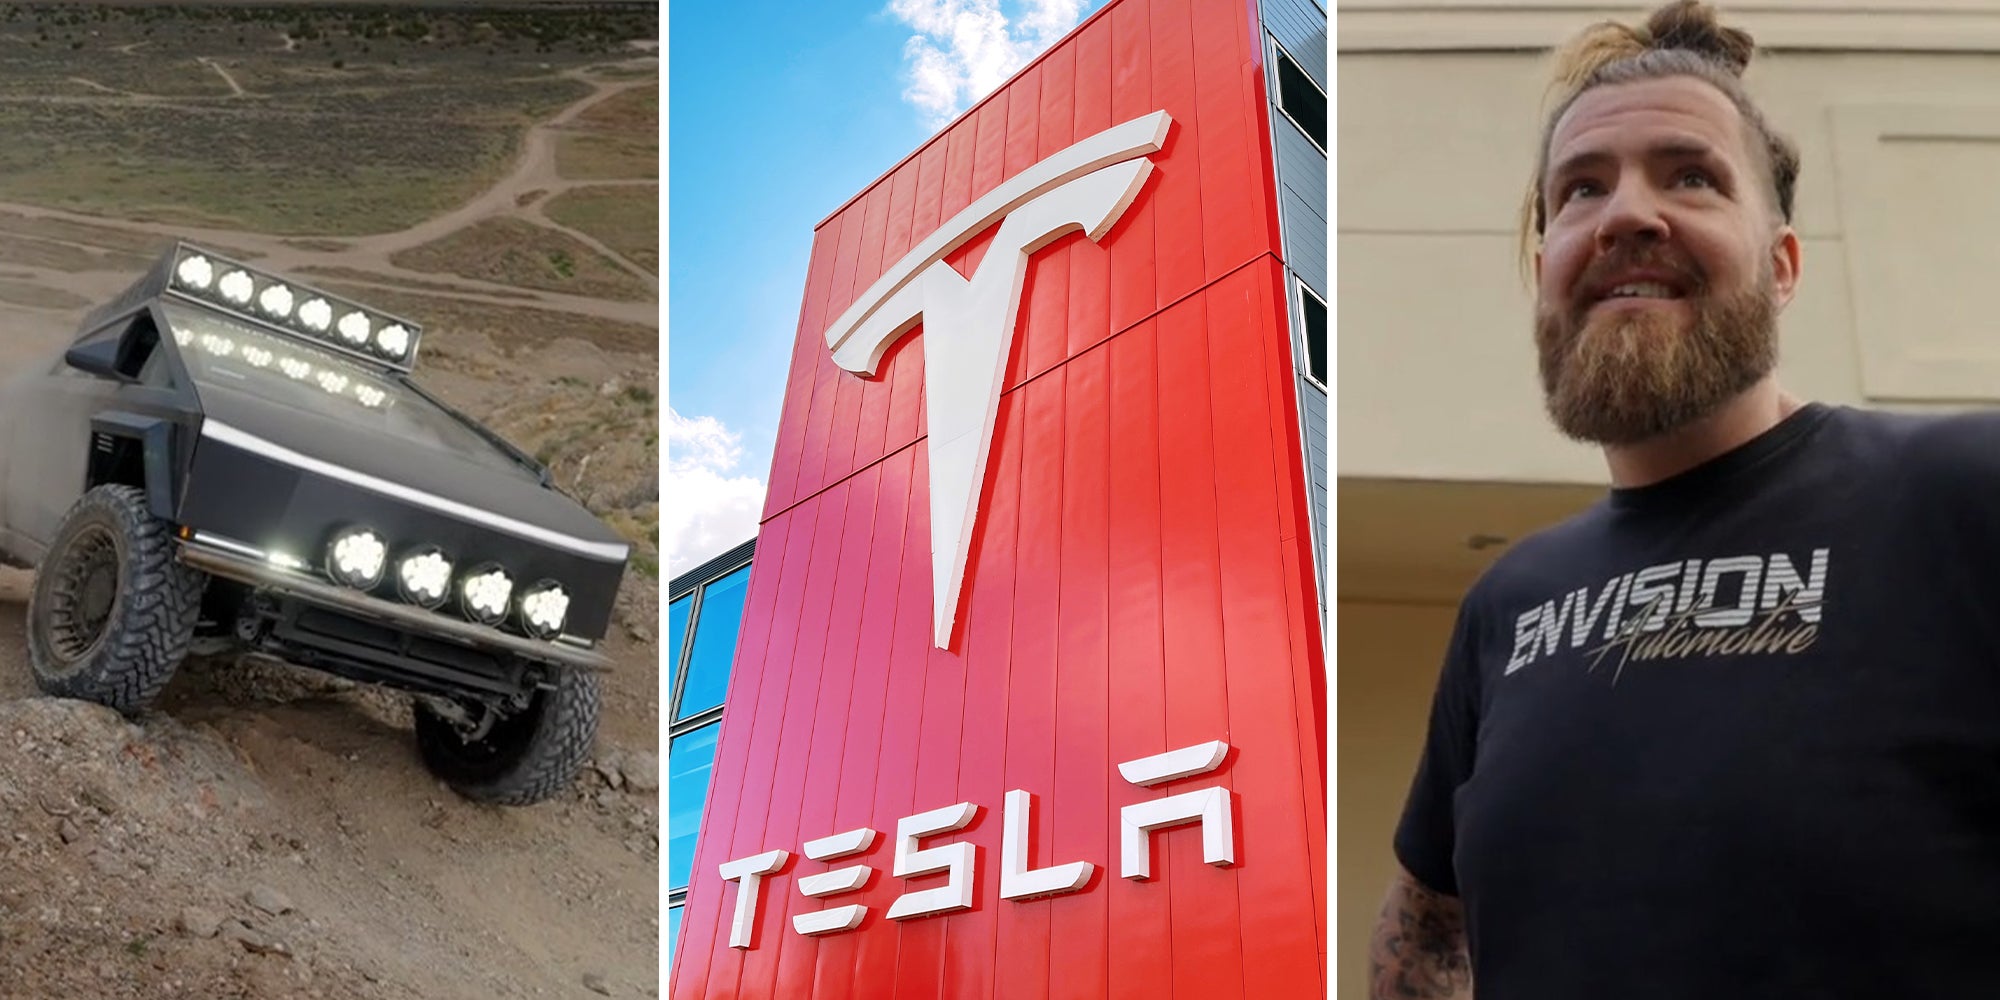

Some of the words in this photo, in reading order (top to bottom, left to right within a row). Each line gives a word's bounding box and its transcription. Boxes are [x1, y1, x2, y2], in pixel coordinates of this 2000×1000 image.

[1504, 548, 1830, 676] ENVISION
[1585, 588, 1828, 687] Automotive
[719, 740, 1235, 949] TESLA
